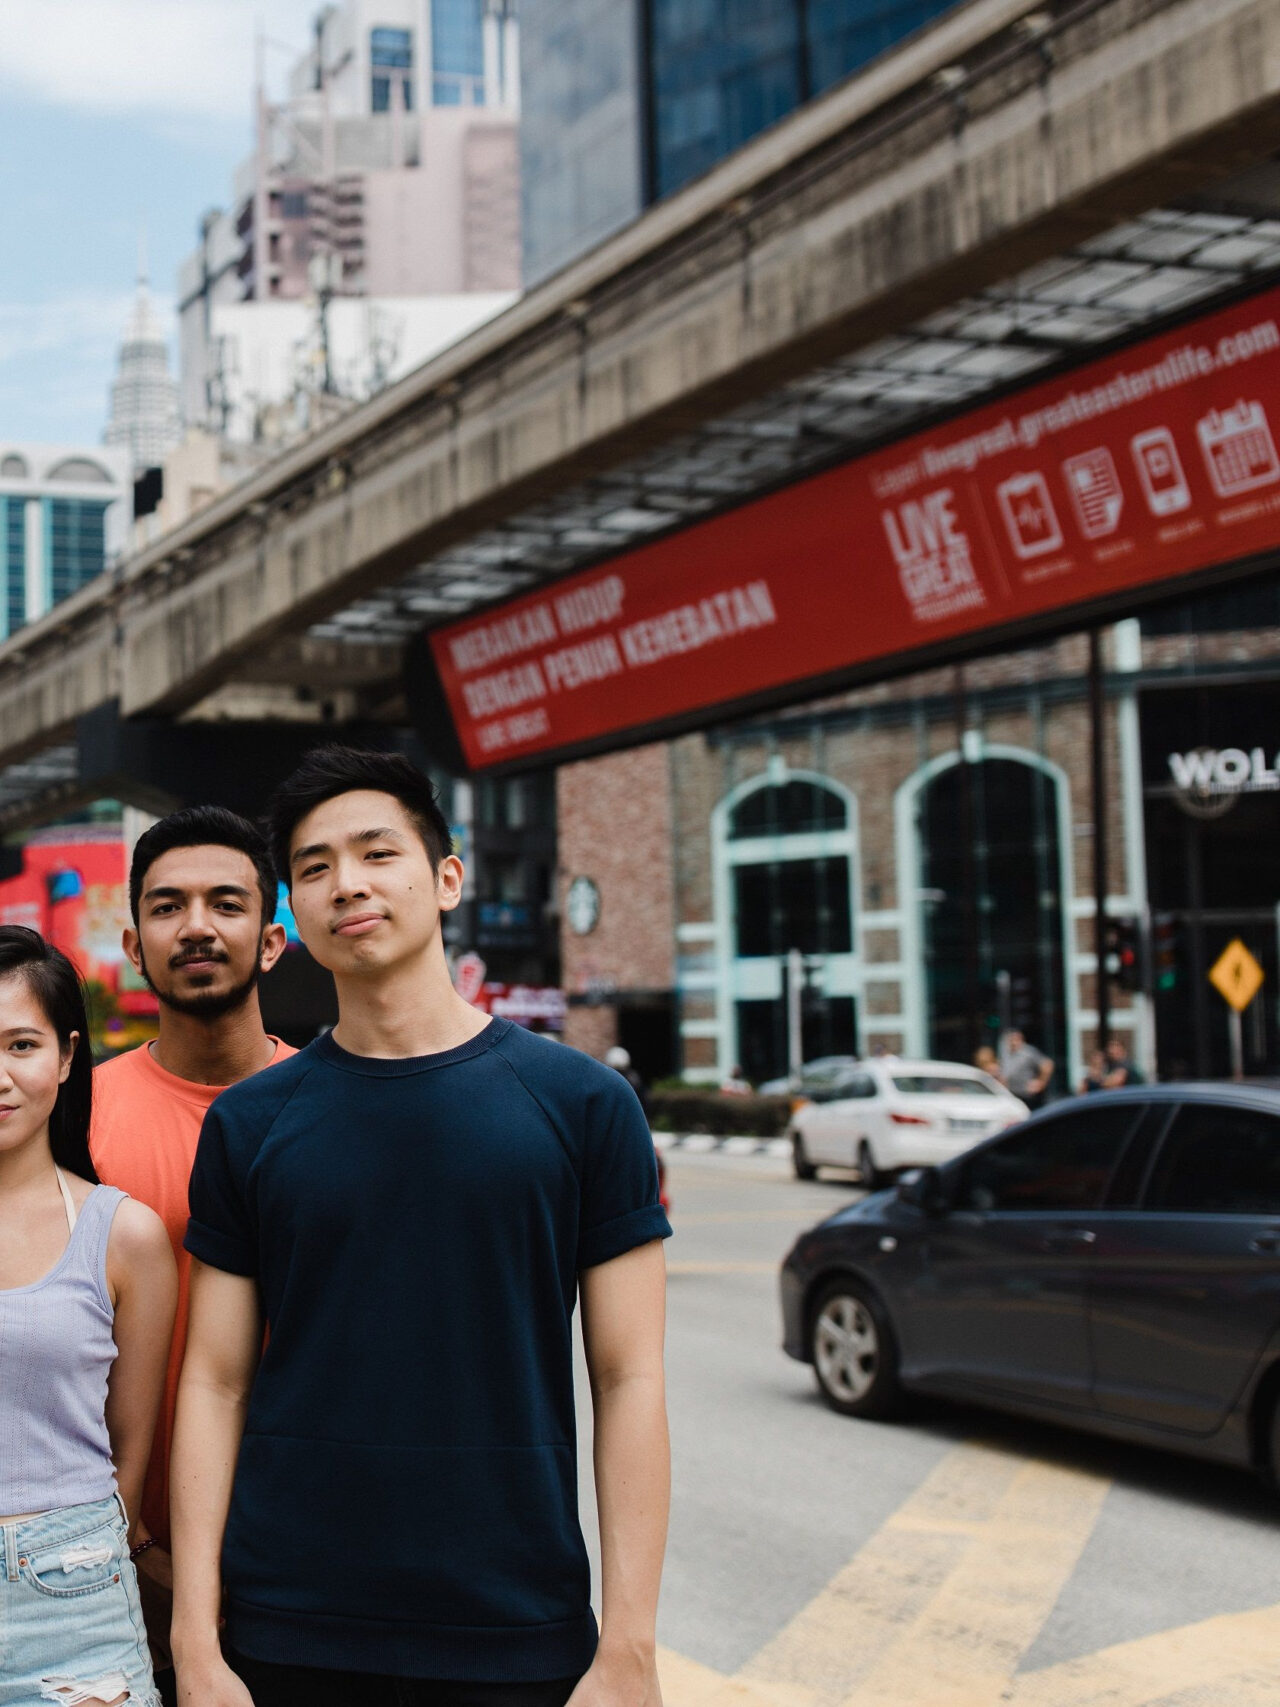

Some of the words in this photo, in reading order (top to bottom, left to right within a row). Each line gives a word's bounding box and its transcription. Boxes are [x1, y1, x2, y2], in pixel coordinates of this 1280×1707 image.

[881, 486, 968, 567] LIVE
[554, 574, 625, 634] HIDUP
[461, 659, 547, 720] DENGAN
[542, 632, 623, 694] PENUH
[618, 578, 777, 671] KEHEBATAN
[1167, 746, 1280, 791] WOL
